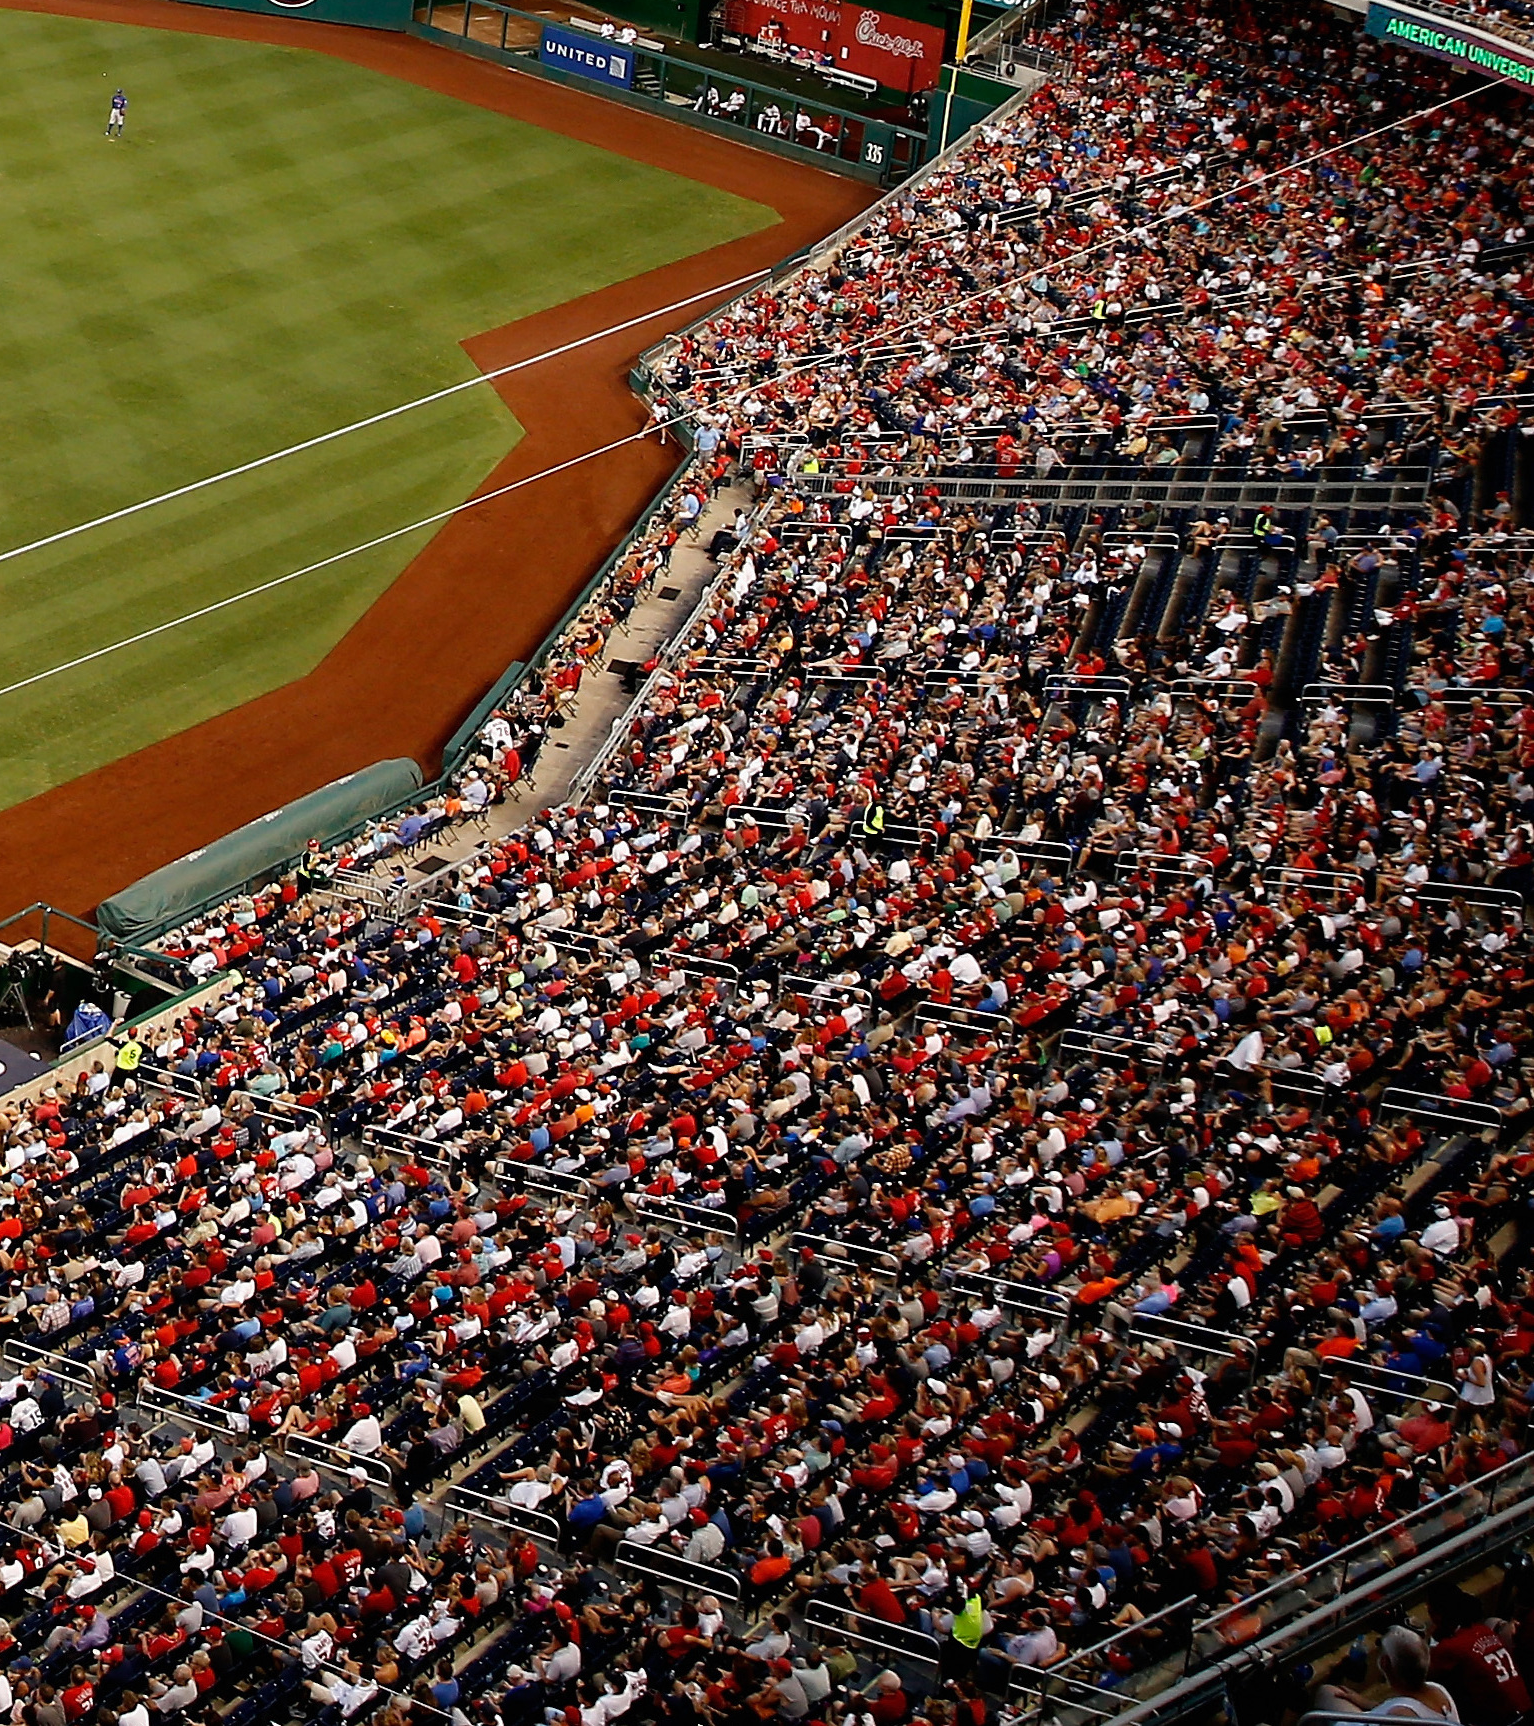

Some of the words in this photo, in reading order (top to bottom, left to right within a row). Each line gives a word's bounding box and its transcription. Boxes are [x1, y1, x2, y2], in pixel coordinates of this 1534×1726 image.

[1386, 18, 1467, 57] AMERICAN
[545, 39, 608, 70] UNITED
[865, 140, 885, 164] 335
